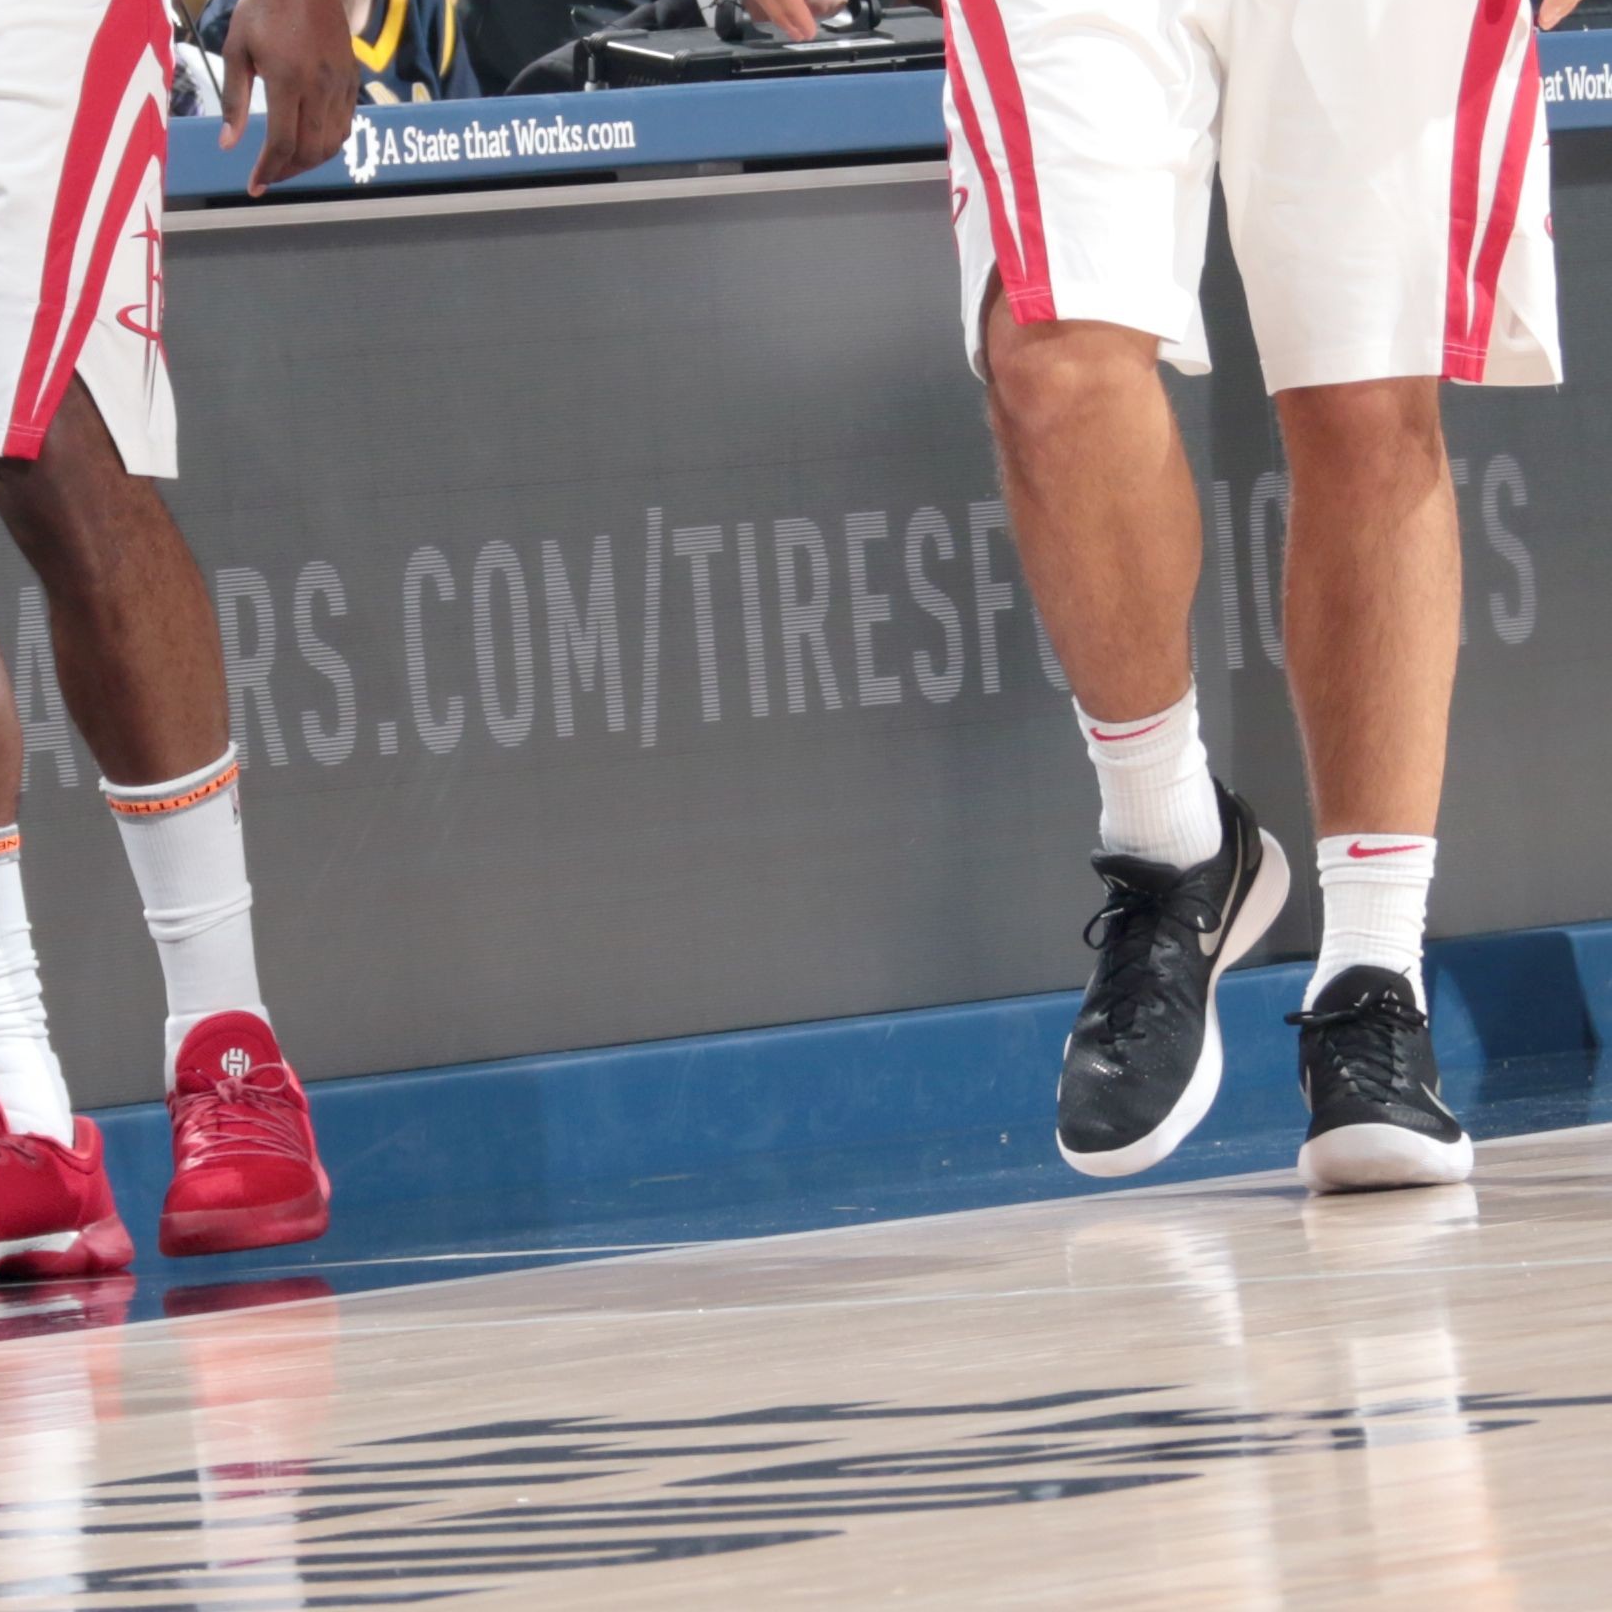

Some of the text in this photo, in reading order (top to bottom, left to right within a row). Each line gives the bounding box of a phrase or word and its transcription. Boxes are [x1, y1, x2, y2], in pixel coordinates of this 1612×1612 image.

[382, 115, 636, 165] A State that Works.com
